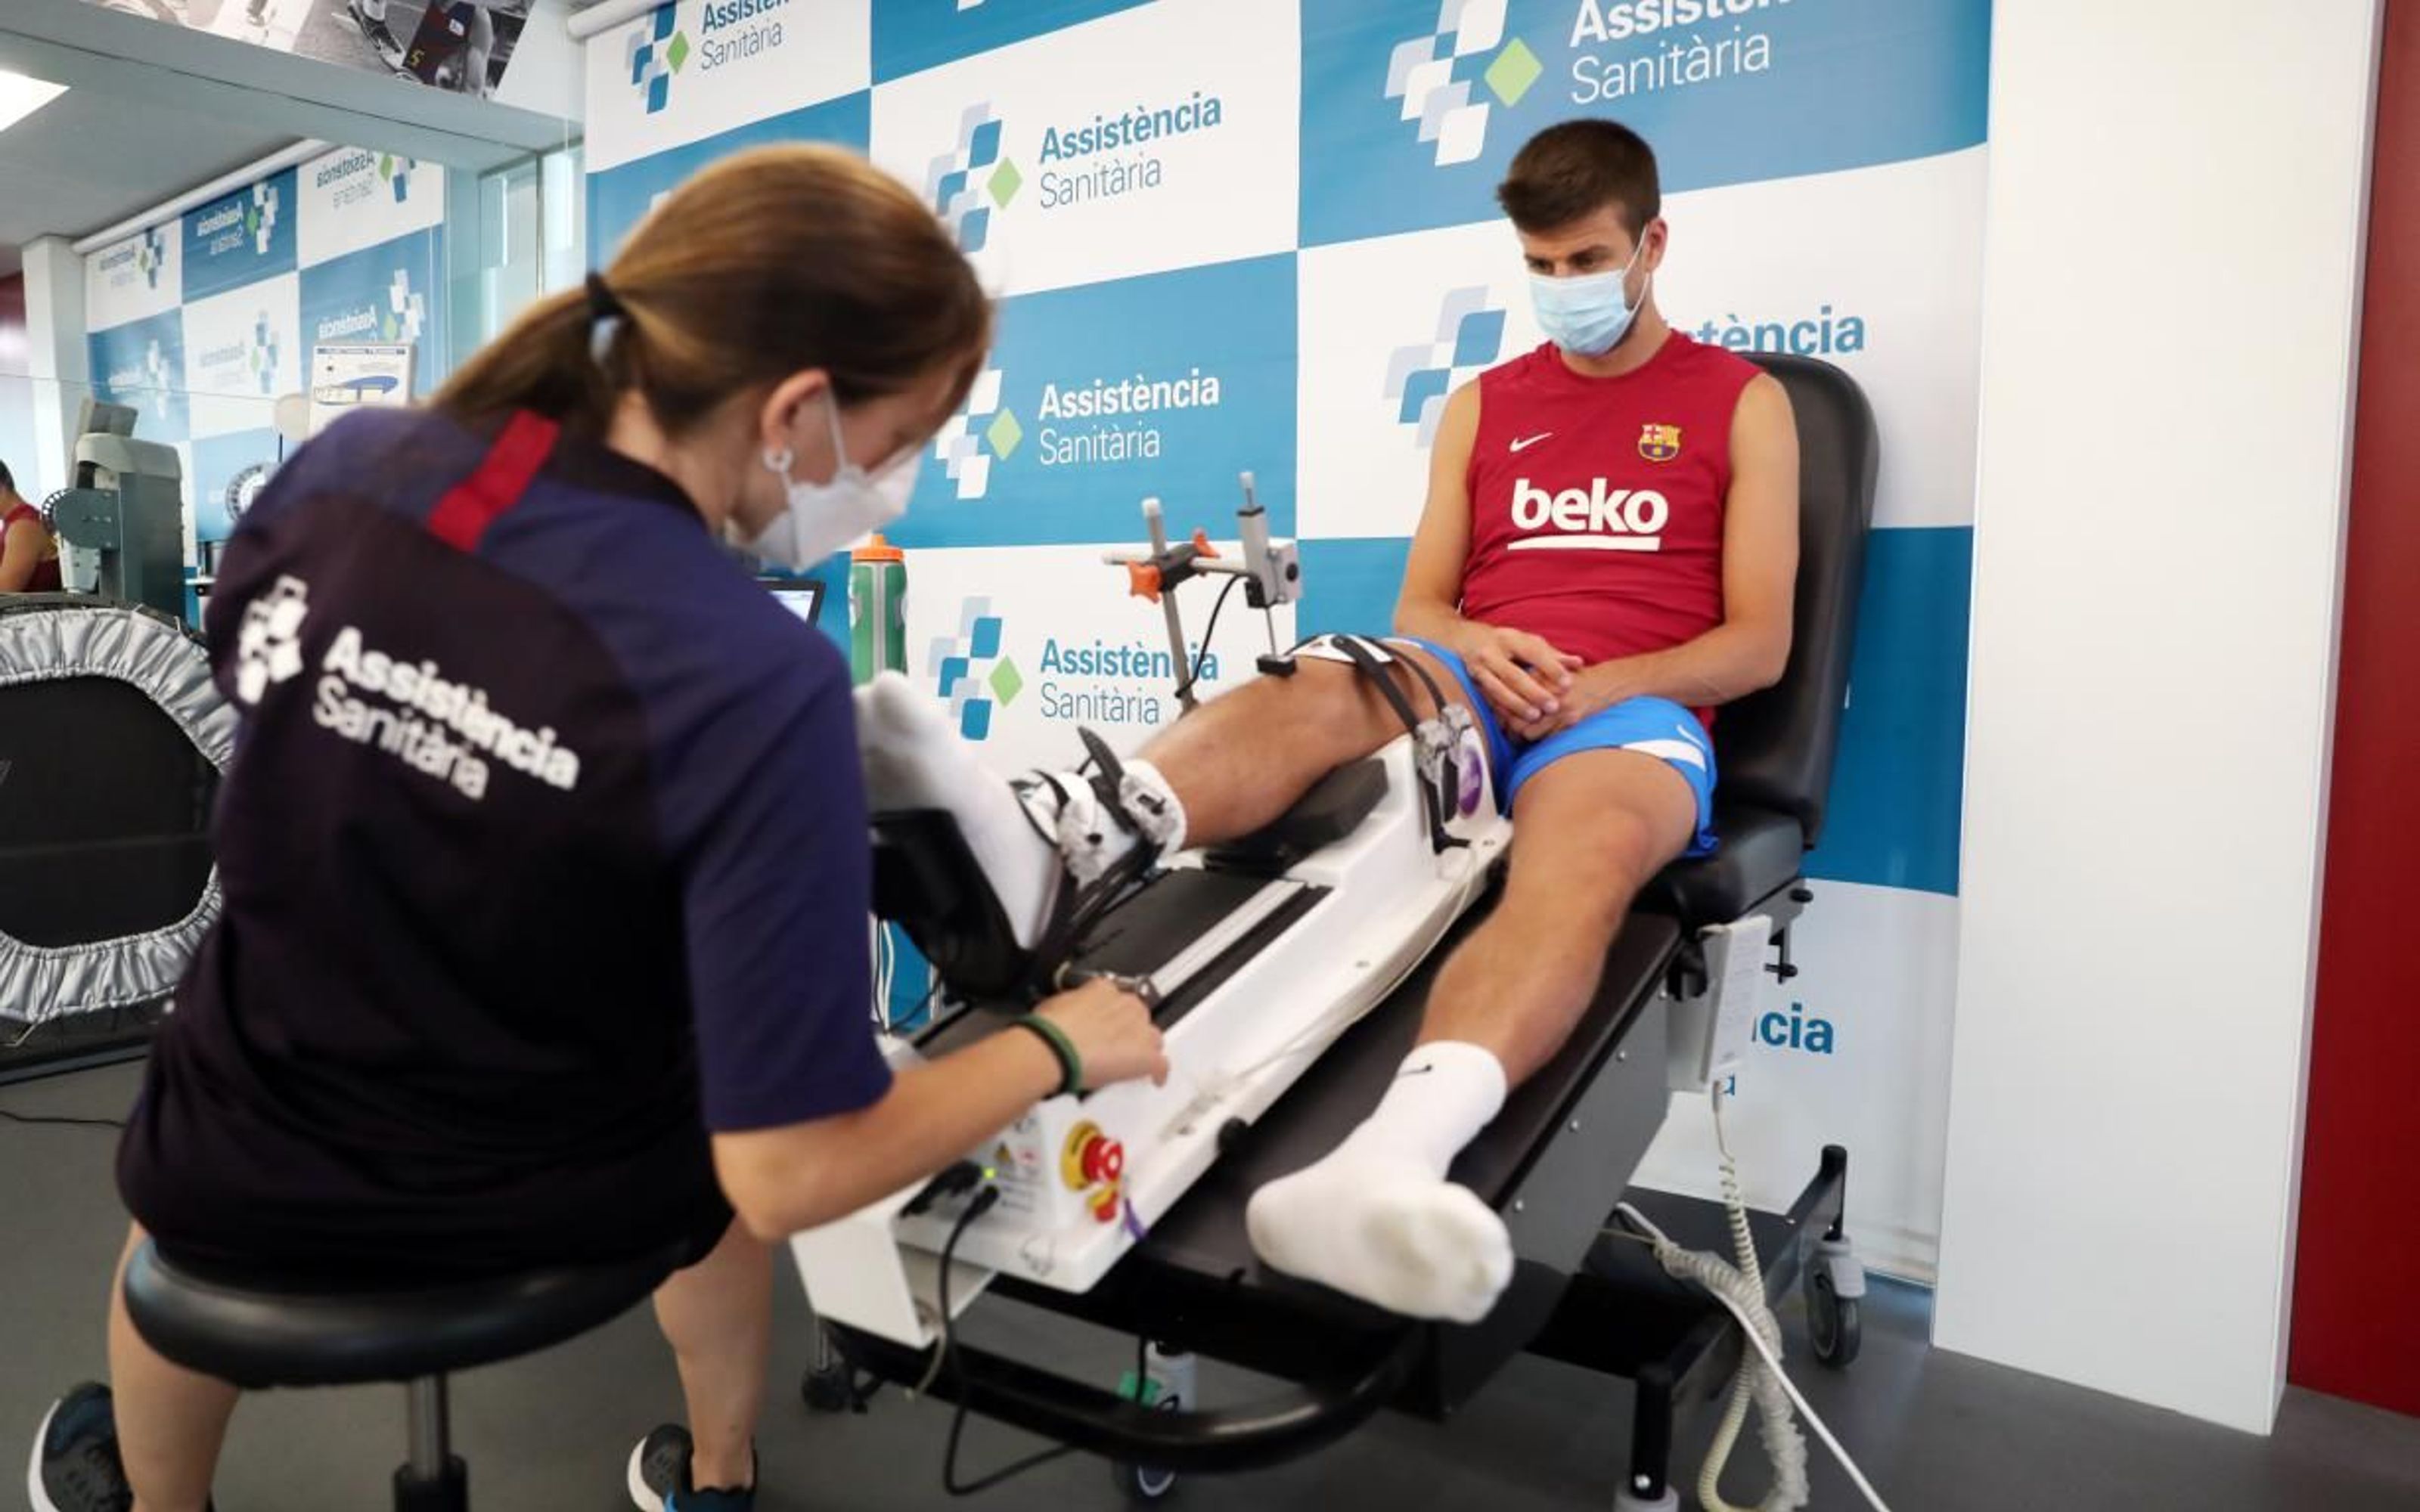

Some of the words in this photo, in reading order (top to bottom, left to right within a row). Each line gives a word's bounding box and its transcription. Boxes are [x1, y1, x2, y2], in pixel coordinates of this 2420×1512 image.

[702, 18, 782, 70] Sanitària
[1571, 25, 1770, 104] Sanitària
[1041, 91, 1221, 163] Assistència
[1041, 152, 1161, 208] Sanitària
[1038, 367, 1219, 420] Assistència
[1040, 420, 1159, 465] Sanitària
[1512, 478, 1668, 534] beko
[1041, 639, 1218, 680] Assistènia
[323, 626, 580, 790] Assistència
[1041, 683, 1159, 723] Sanitària
[313, 675, 489, 799] Sanitària
[1752, 1002, 1834, 1053] cia
